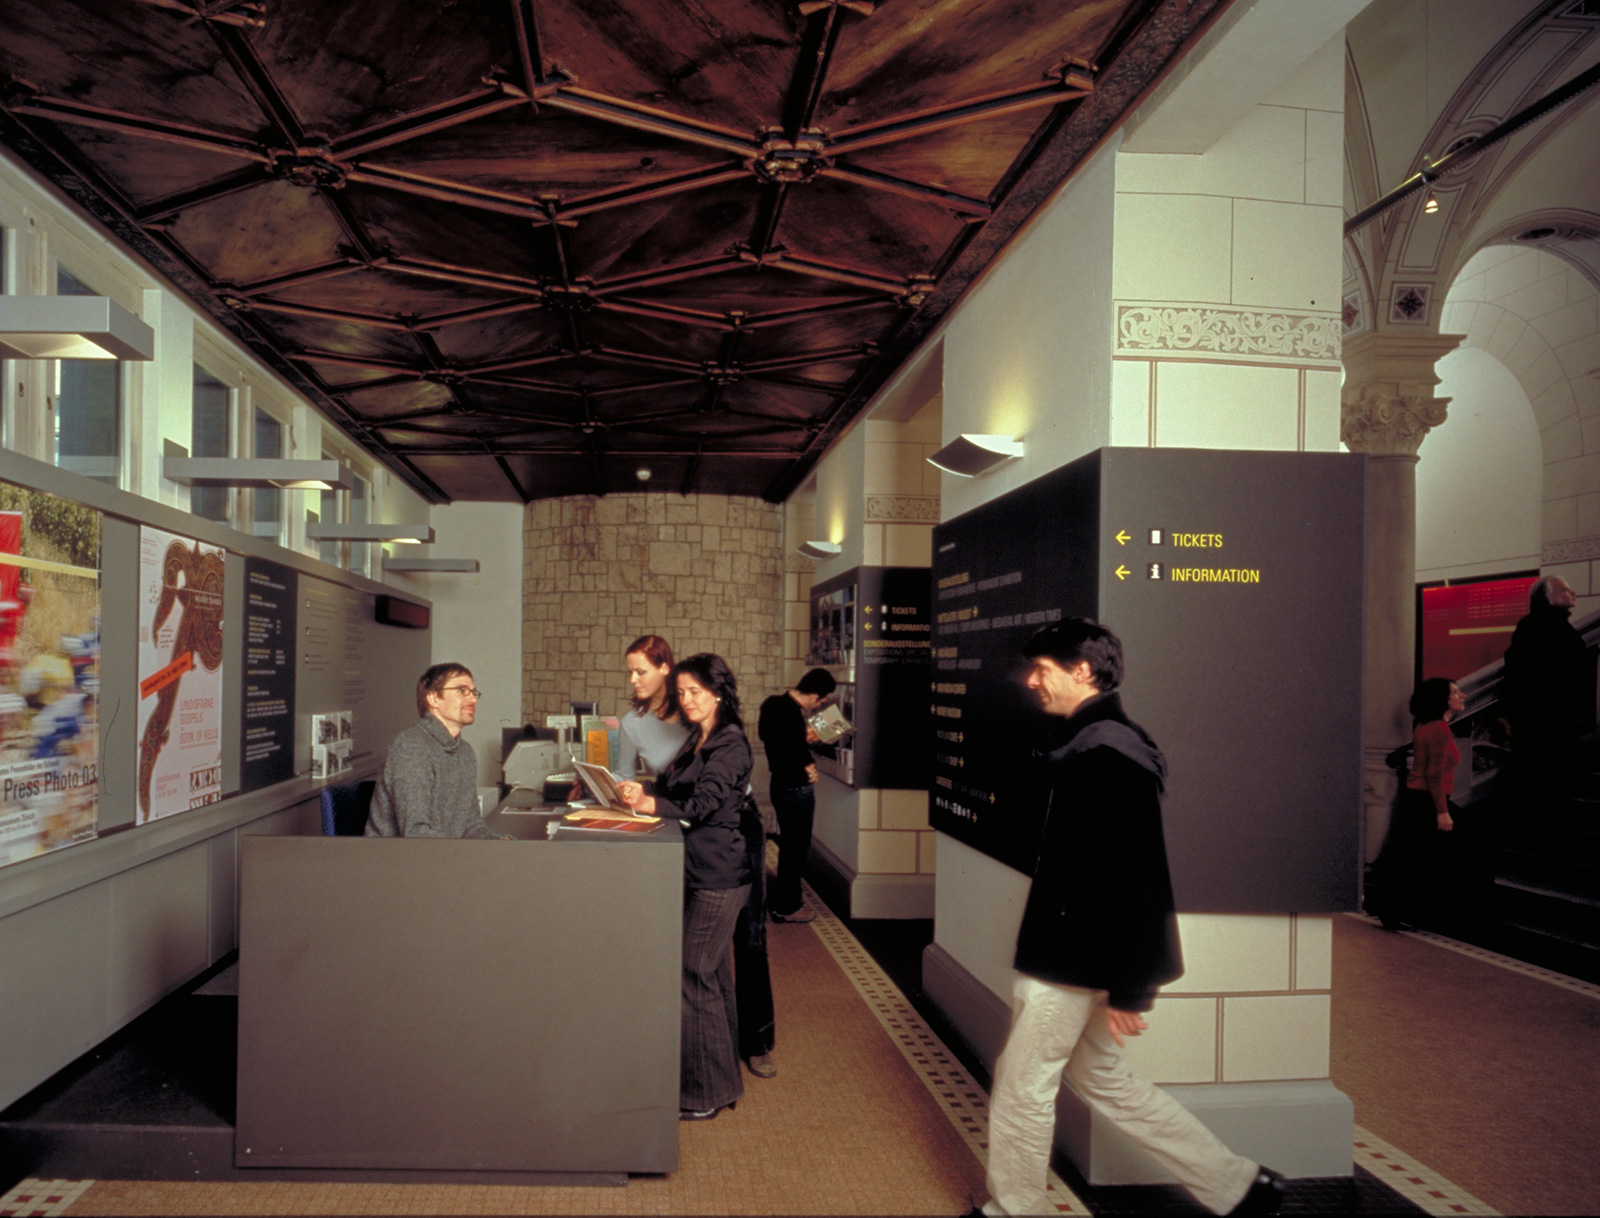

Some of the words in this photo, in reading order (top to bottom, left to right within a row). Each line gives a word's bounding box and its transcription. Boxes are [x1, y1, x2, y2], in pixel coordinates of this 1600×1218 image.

[1171, 532, 1223, 548] TICKETS
[1171, 567, 1260, 583] INFORMATION
[891, 606, 917, 615] TICKETS
[180, 697, 215, 711] LINDISFARNE
[180, 712, 204, 726] GOSPELS
[179, 730, 195, 745] BOOK
[195, 729, 203, 742] OF
[203, 727, 219, 740] KELLS
[4, 778, 40, 802] Press
[44, 769, 79, 793] Photo
[82, 764, 97, 785] 03
[21, 812, 36, 822] Zürich
